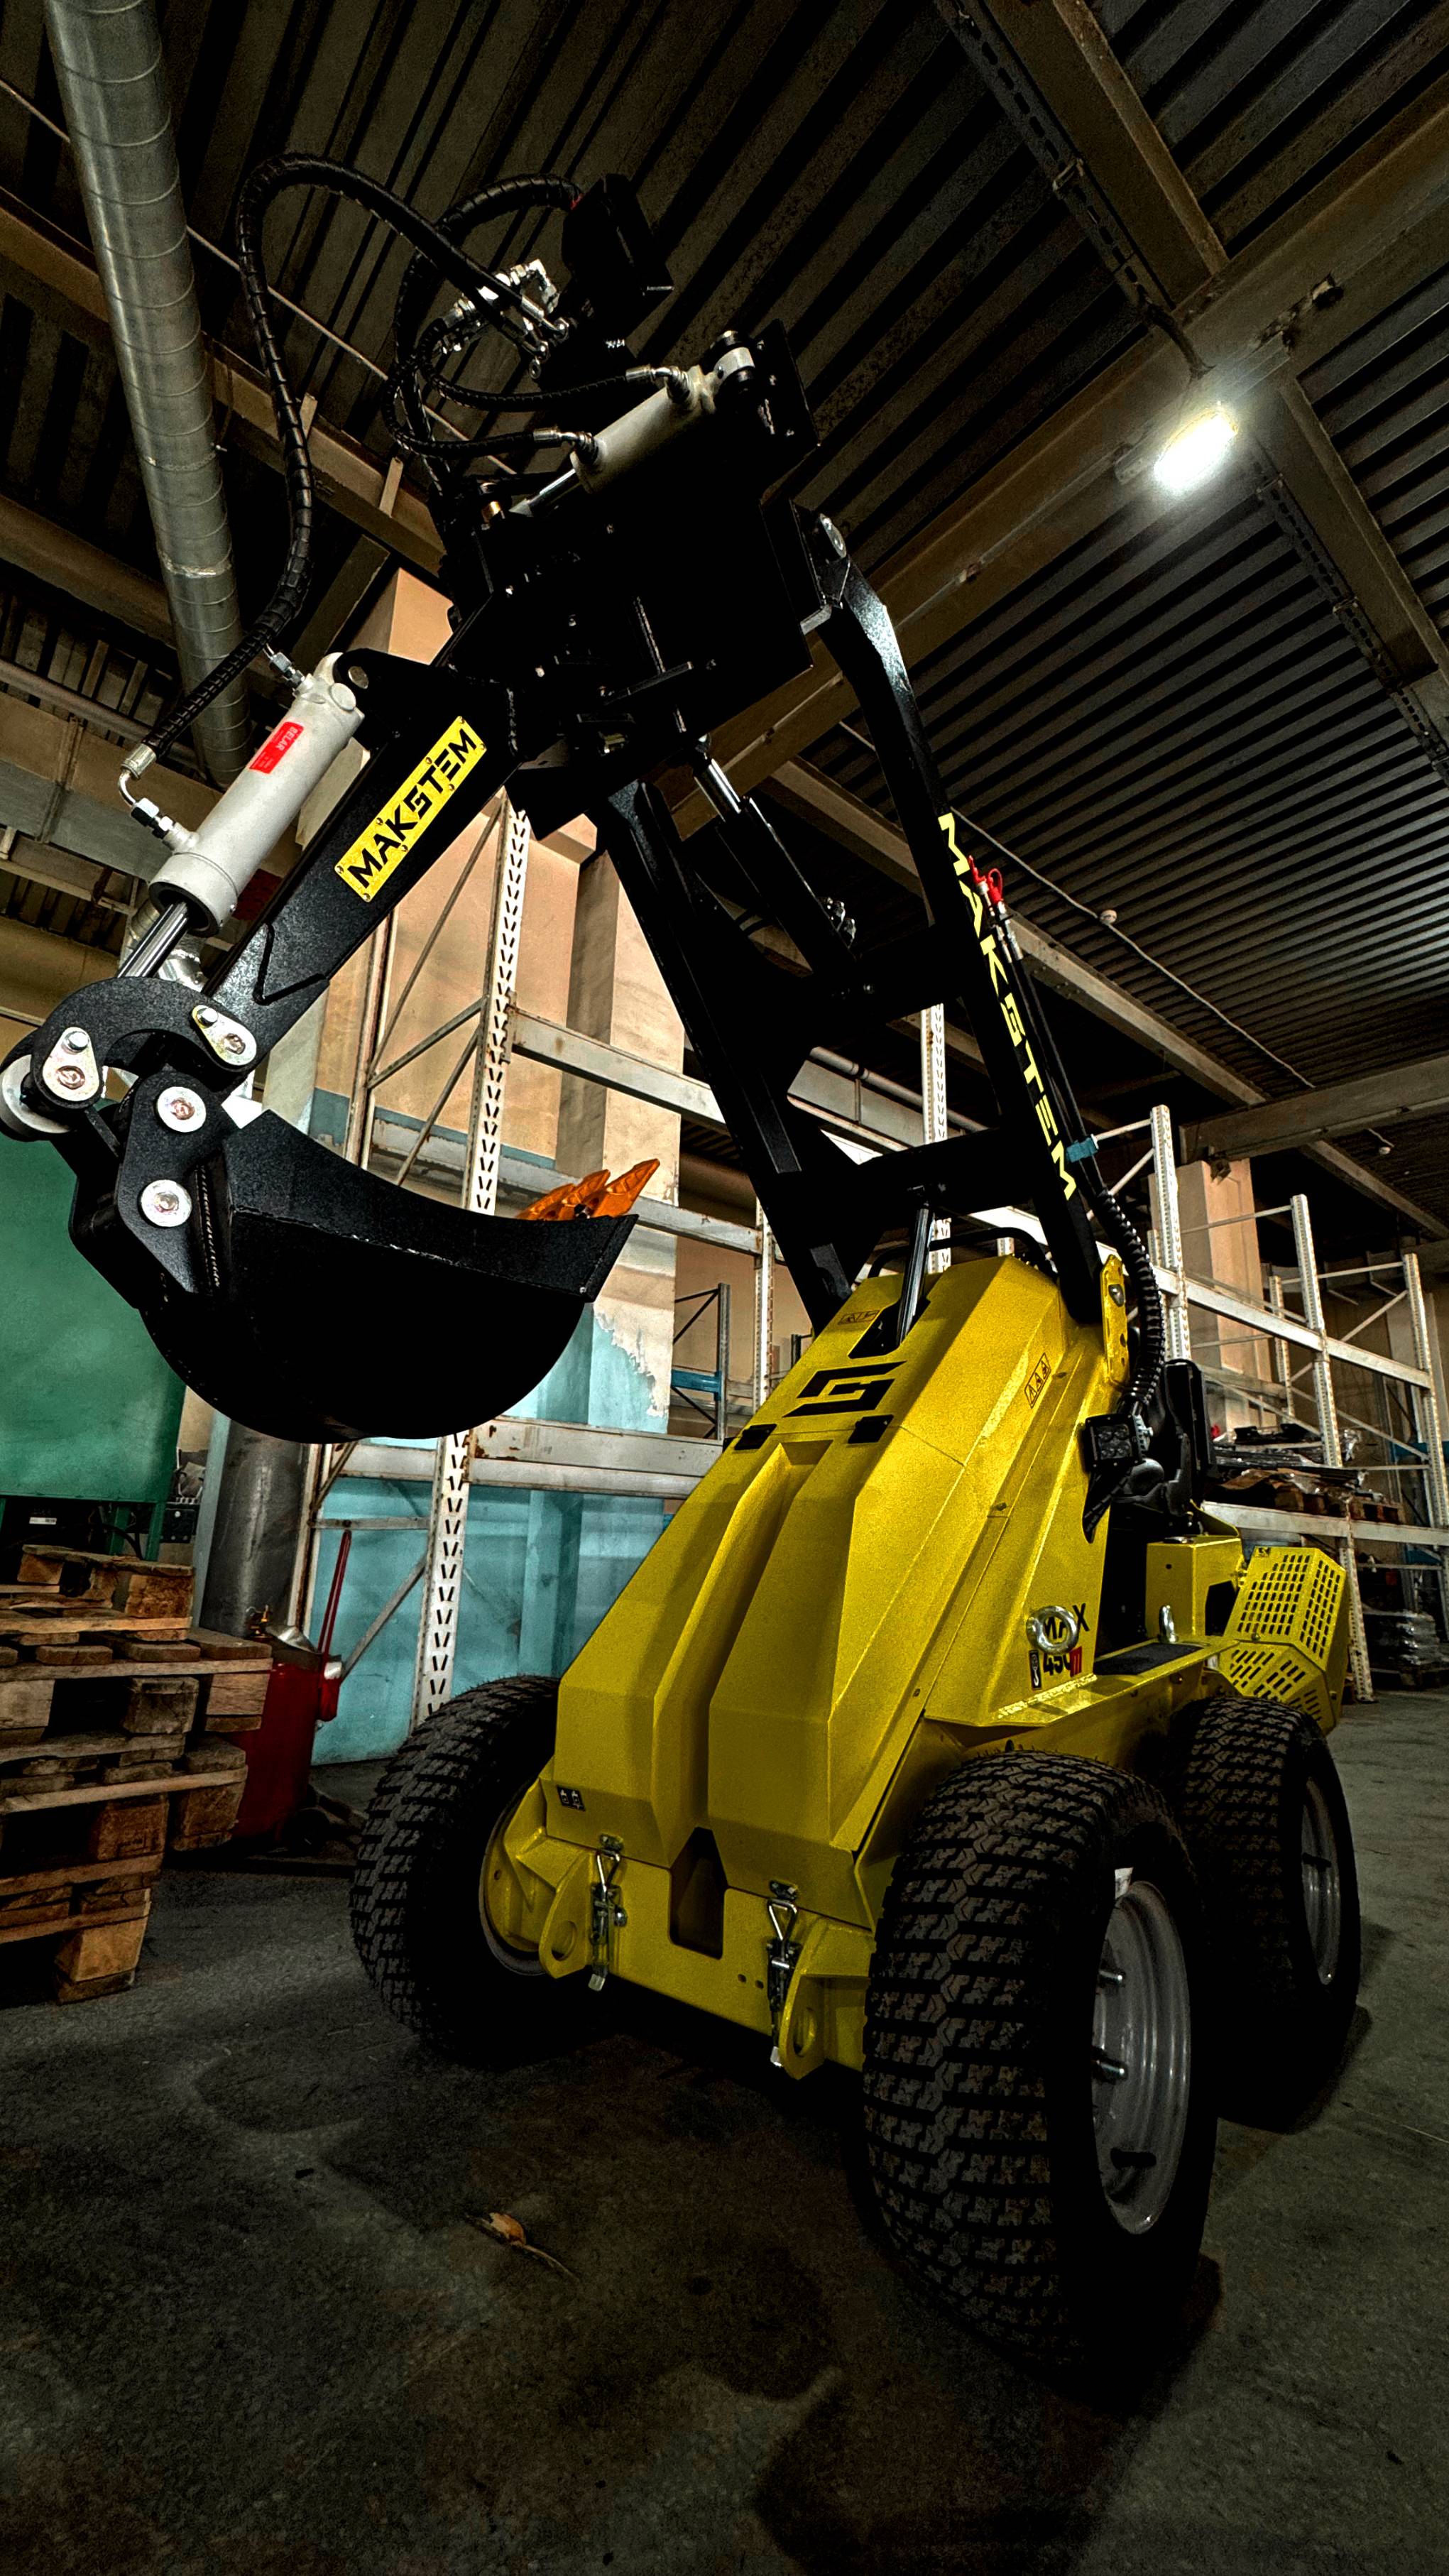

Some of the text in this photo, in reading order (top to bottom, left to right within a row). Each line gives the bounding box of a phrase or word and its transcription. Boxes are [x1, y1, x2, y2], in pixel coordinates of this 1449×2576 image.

[275, 726, 299, 751] BELAR
[347, 728, 477, 889] MAKSTEM
[938, 812, 1077, 1201] MAKSTEM
